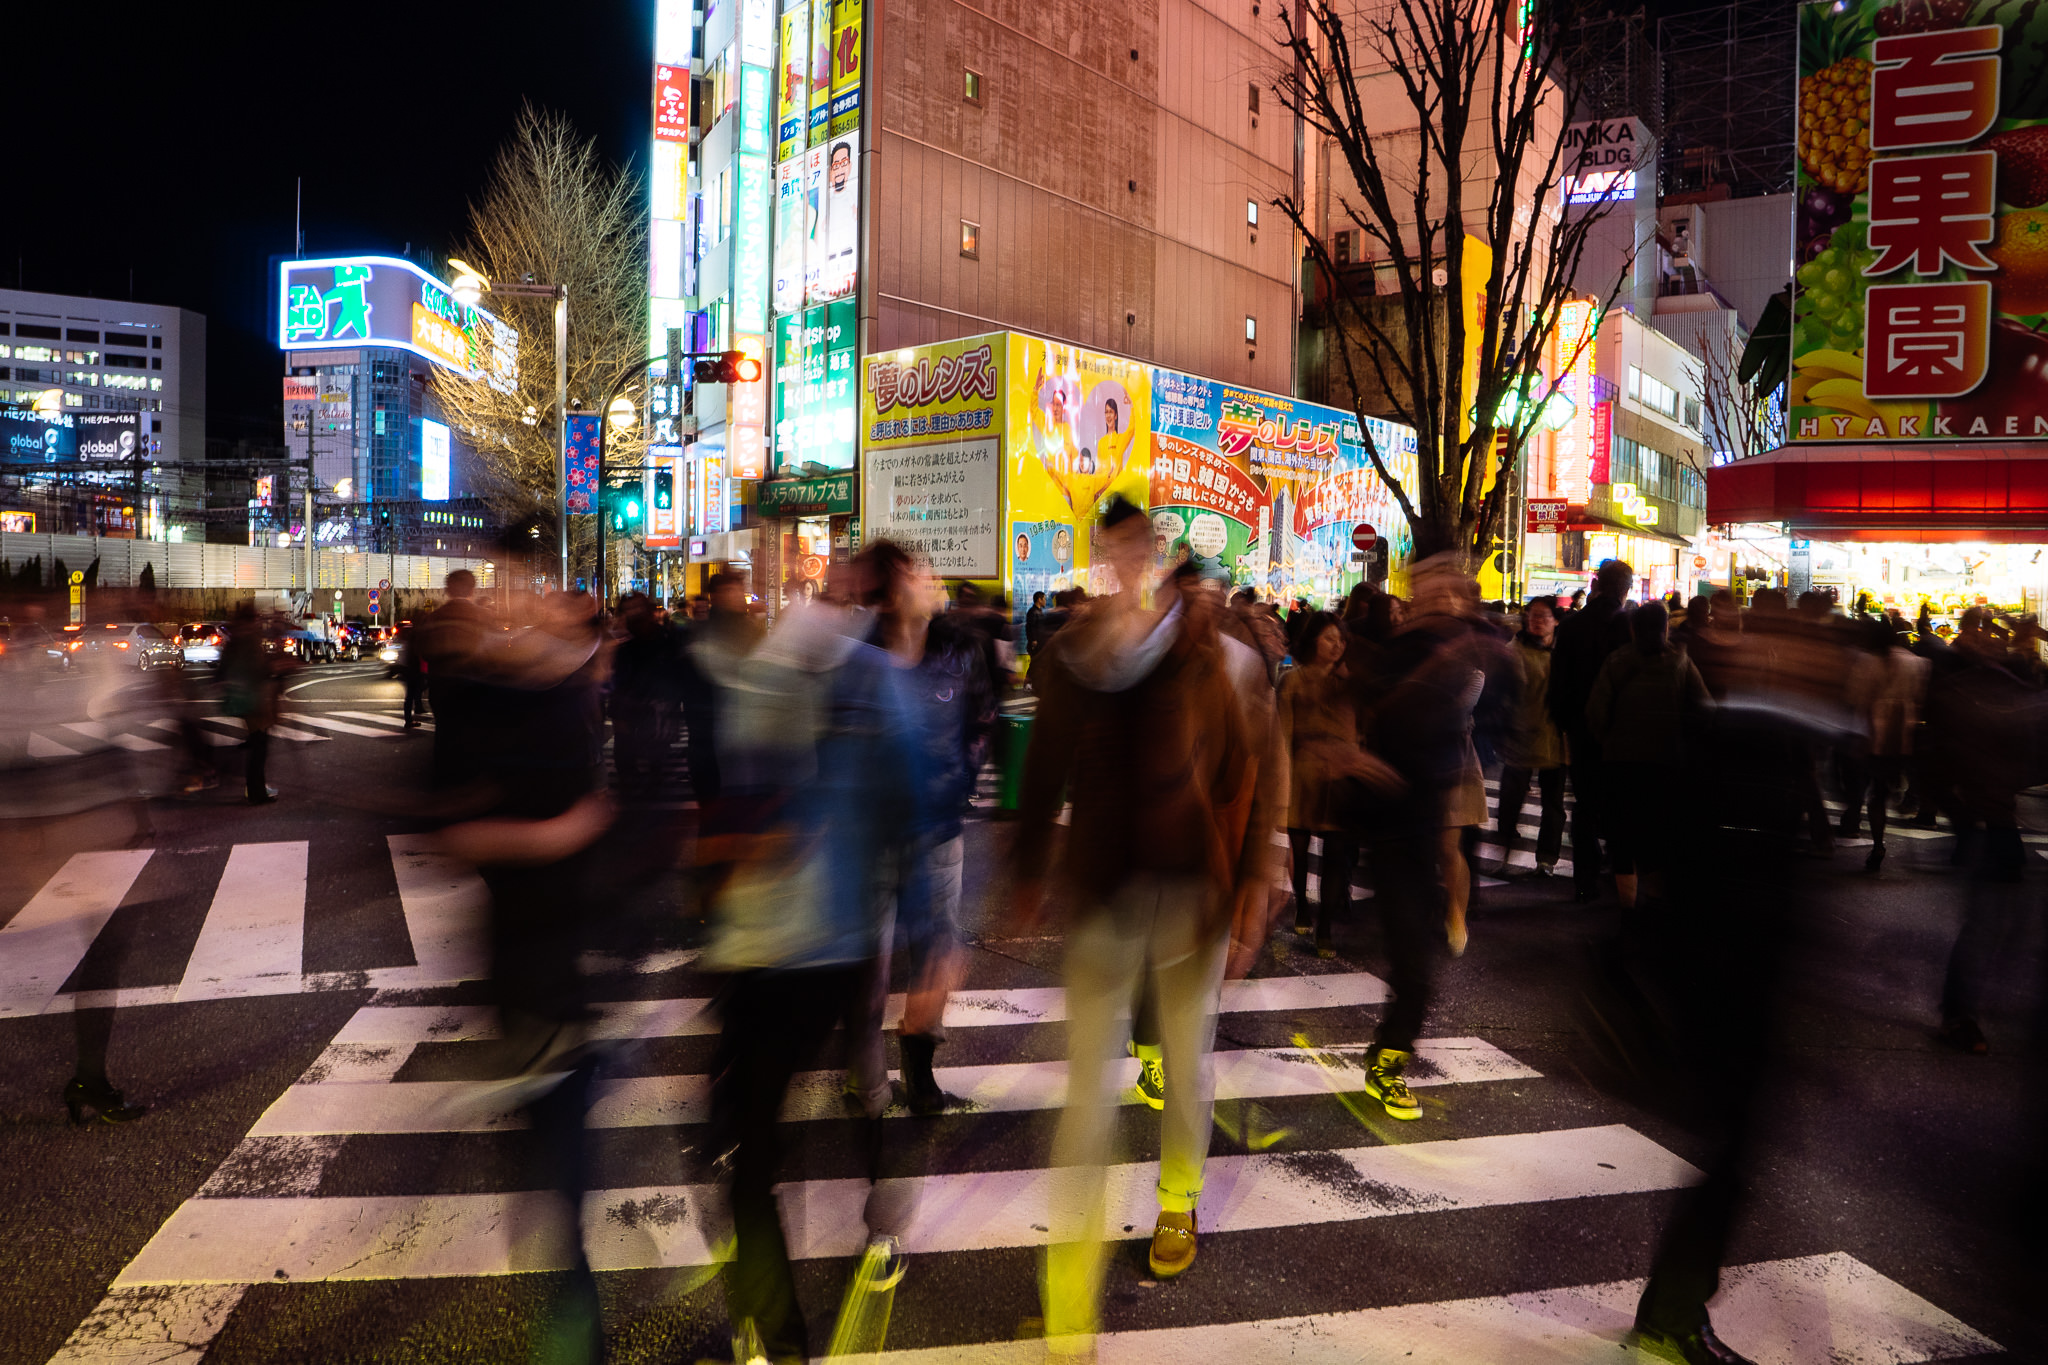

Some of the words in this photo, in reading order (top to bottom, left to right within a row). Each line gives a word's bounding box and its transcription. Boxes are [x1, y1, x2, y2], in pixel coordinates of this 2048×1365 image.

[1862, 24, 2003, 400] 百果園
[739, 380, 758, 476] ールドラッシュ
[870, 406, 993, 440] と呼ばれるには、理由があります
[1217, 400, 1340, 458] 夢のレンズ
[10, 434, 43, 454] global
[79, 440, 118, 462] global
[1158, 437, 1230, 473] 夢のレンズを求めて
[761, 480, 848, 505] カメラのアルプス堂
[1155, 453, 1255, 512] 中国、韓国からも
[1172, 484, 1241, 515] お越しになります
